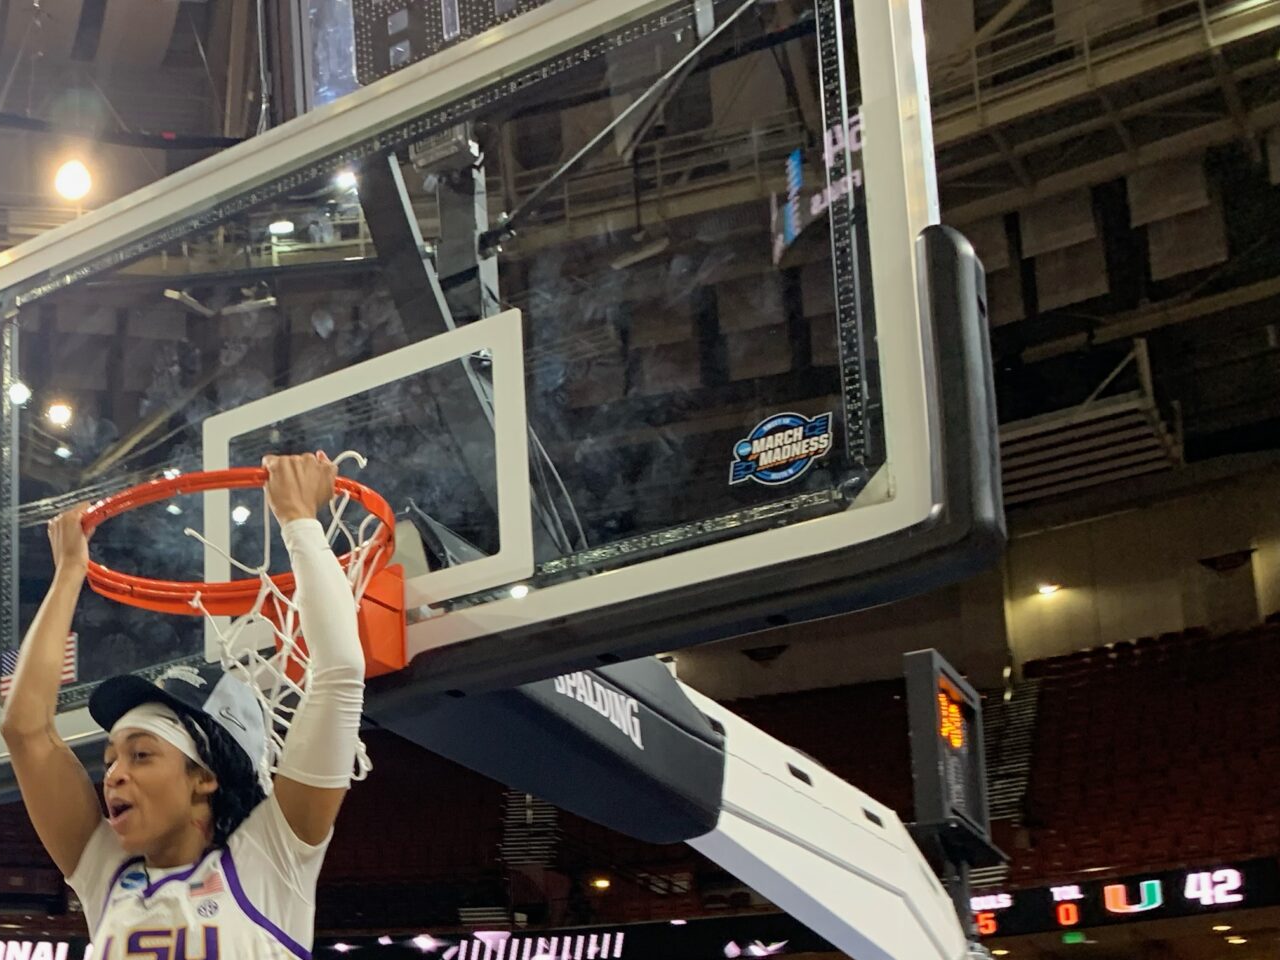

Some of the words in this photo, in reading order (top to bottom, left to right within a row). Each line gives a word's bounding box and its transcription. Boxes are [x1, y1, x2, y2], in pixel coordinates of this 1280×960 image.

[751, 425, 804, 455] MARCH
[759, 433, 829, 467] MADNESS
[1184, 868, 1245, 906] 42
[1056, 902, 1080, 926] 0
